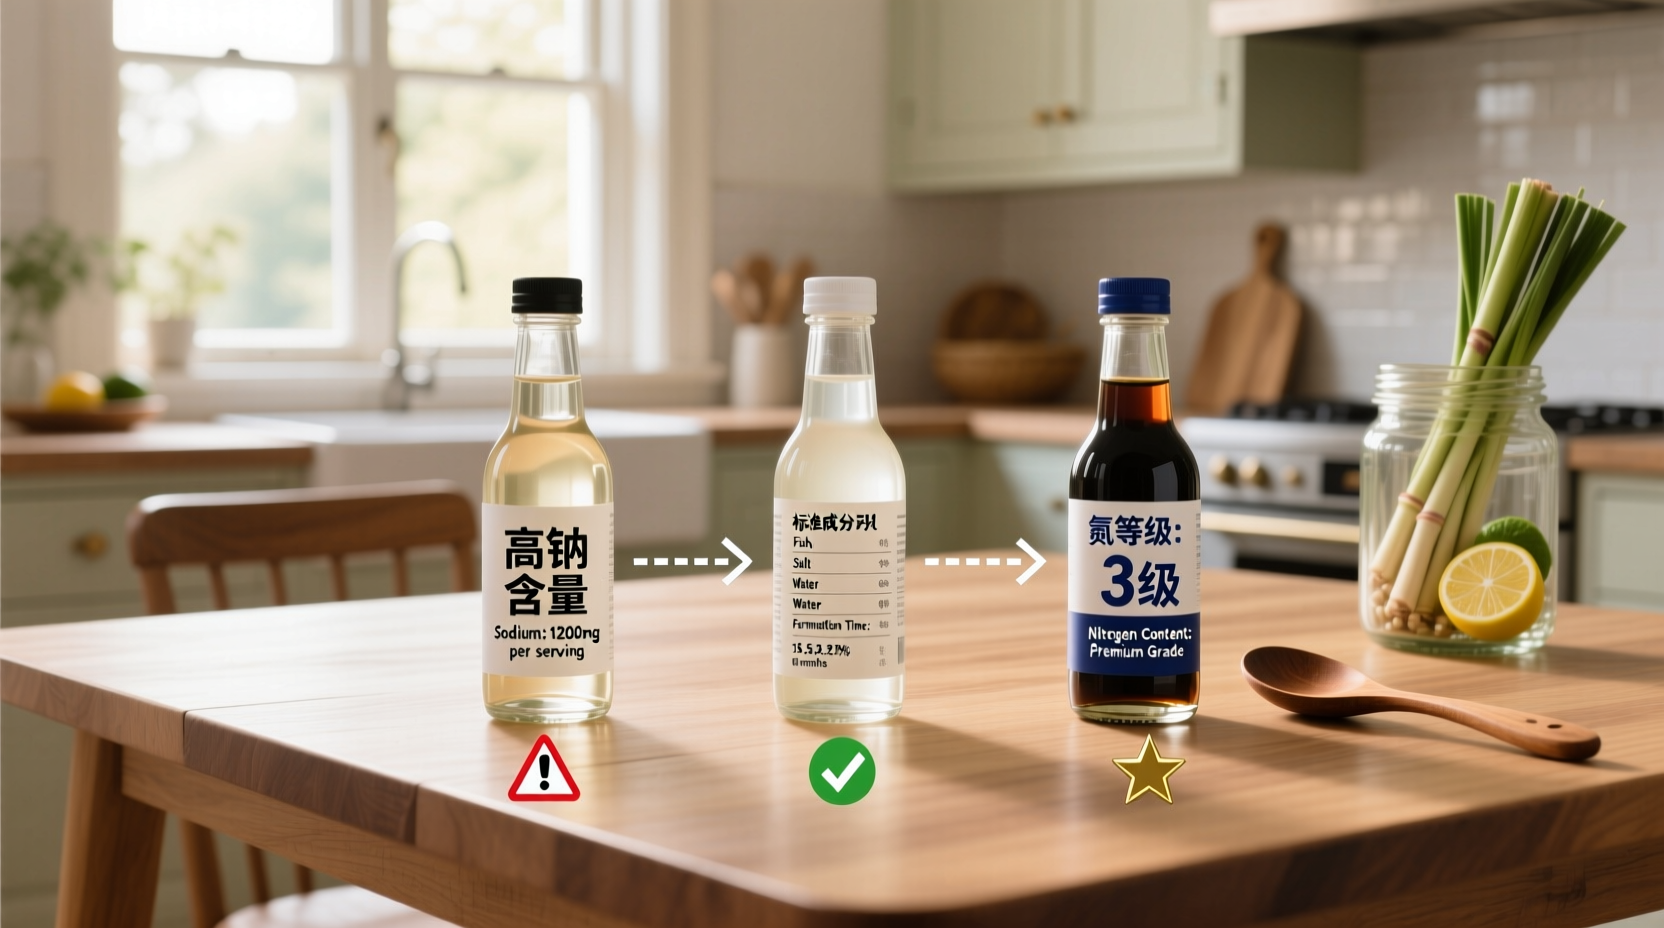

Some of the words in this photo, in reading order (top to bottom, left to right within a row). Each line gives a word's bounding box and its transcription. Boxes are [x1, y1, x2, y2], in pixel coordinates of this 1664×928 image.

[505, 526, 588, 570] 高钠
[792, 577, 819, 590] Water
[1101, 554, 1180, 608] 3级
[504, 573, 588, 616] 含量
[792, 598, 822, 610] Water
[494, 624, 547, 640] Sodium:
[1141, 627, 1192, 640] Content:
[509, 646, 531, 661] per
[535, 643, 585, 661] serving
[1089, 643, 1144, 658] Premium
[1147, 643, 1184, 658] Grade
